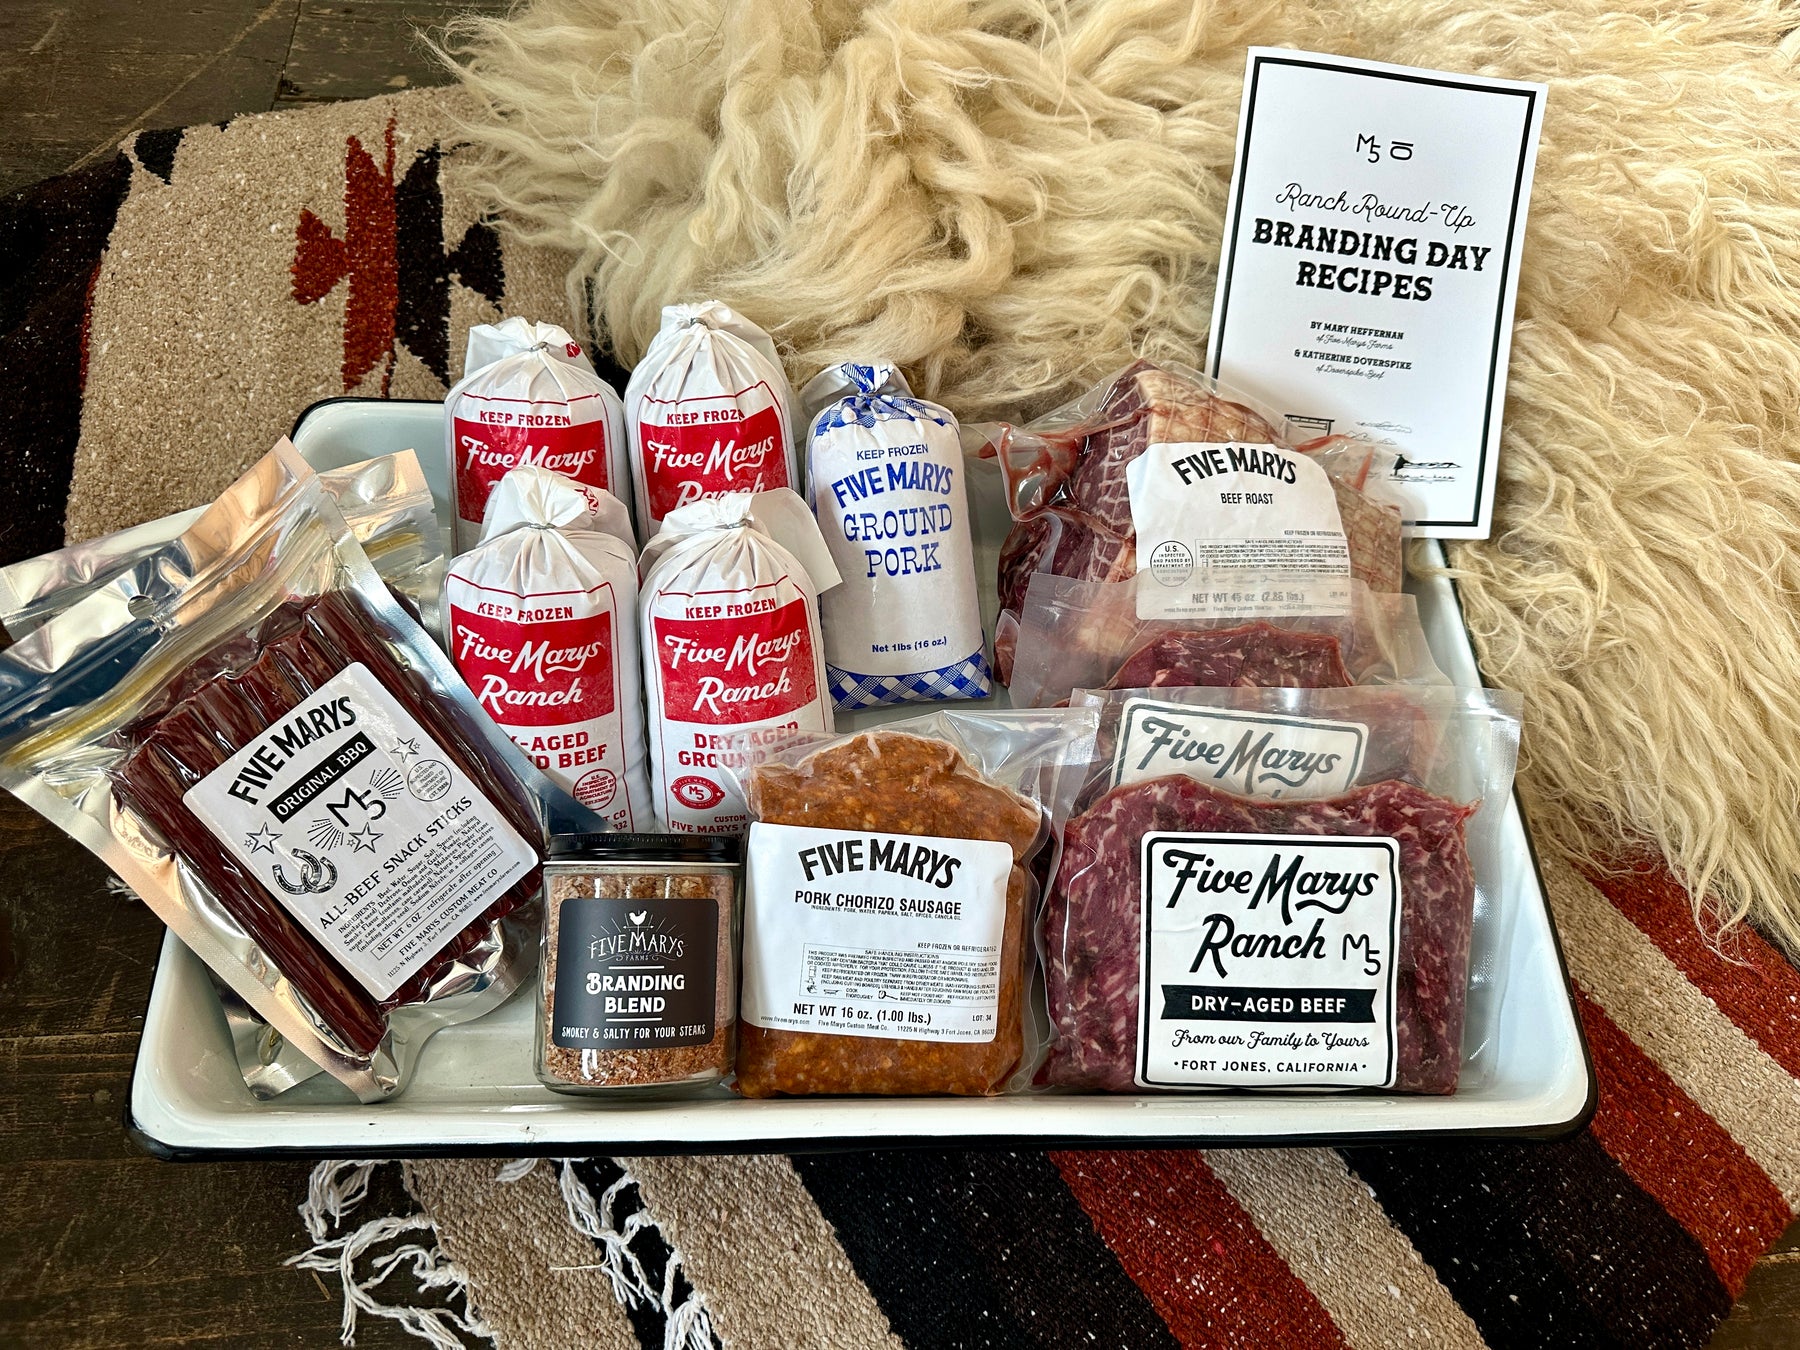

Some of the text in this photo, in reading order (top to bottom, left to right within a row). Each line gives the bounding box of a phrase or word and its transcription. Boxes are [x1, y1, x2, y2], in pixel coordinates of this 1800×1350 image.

[1275, 182, 1475, 234] Ranch Round-Up
[1252, 218, 1491, 272] BRANDING DAY
[1296, 261, 1433, 302] RECIPES
[1310, 321, 1404, 340] BY MARY HEFFERNAN
[1294, 349, 1412, 370] & KATHERINE DOVERSPIKE
[479, 410, 571, 427] KEEP FROZEN
[666, 411, 700, 425] KEEP
[461, 435, 596, 477] Five Marys
[647, 435, 775, 481] Five Marys
[856, 444, 929, 461] KEEP FROZEN
[1171, 447, 1297, 486] FIVE MARYS
[831, 461, 954, 509] FIVE MARYS
[1220, 492, 1274, 504] BEEF ROAST
[843, 504, 953, 542] GROUND
[865, 542, 942, 578] PORK
[685, 597, 776, 619] KEEP FROZEN
[1192, 593, 1209, 604] NET
[1212, 592, 1228, 603] WT
[477, 602, 574, 623] KEEP FROZEN
[457, 625, 605, 683] Five Marys
[664, 629, 802, 677] Five Marys
[871, 644, 891, 653] Net
[914, 639, 929, 652] (16
[931, 636, 947, 650] oz.)
[478, 674, 584, 715] Ranch
[692, 667, 792, 716] Ranch
[510, 731, 589, 752] -AGED
[694, 721, 799, 750] DRY-AGED
[227, 696, 357, 806] FIVE MARYS
[558, 744, 607, 769] BEEF
[1137, 716, 1342, 794] Five Marys
[276, 740, 369, 817] ORIGINAL BBQ
[613, 809, 626, 820] CO
[672, 820, 693, 833] FIVE
[697, 824, 738, 833] MARYS
[714, 815, 746, 823] CUSTOM
[316, 794, 473, 929] ALL-BEEF SNACK STICKS
[798, 838, 962, 889] FIVE MARYS
[376, 937, 394, 953] NET
[404, 920, 412, 928] 6
[410, 911, 422, 923] OZ
[424, 881, 459, 912] refrigerate
[456, 868, 473, 884] after
[472, 849, 497, 872] opening
[1162, 849, 1379, 926] Five Marys
[398, 867, 498, 956] FIVE MARYS CUSTOM MEAT CO
[795, 890, 962, 915] PORK CHORIZO SAUSAGE
[590, 931, 684, 959] FIVE MARYS
[1189, 913, 1326, 979] Ranch
[586, 972, 685, 995] BRANDING
[604, 997, 666, 1013] BLEND
[793, 1003, 815, 1015] NET
[819, 1004, 837, 1017] WT
[841, 1007, 853, 1018] 16
[857, 1010, 873, 1020] oz.
[877, 1009, 904, 1023] (1.00
[908, 1011, 931, 1026] lbs.)
[1191, 995, 1347, 1014] DRY-AGED BEEF
[561, 1024, 706, 1039] SMOKEY & SALTY FOR YOUR STEAKS
[1172, 1029, 1370, 1051] From our Family to Yours
[1181, 1060, 1358, 1073] FORT JONES, CALIFORNIA
